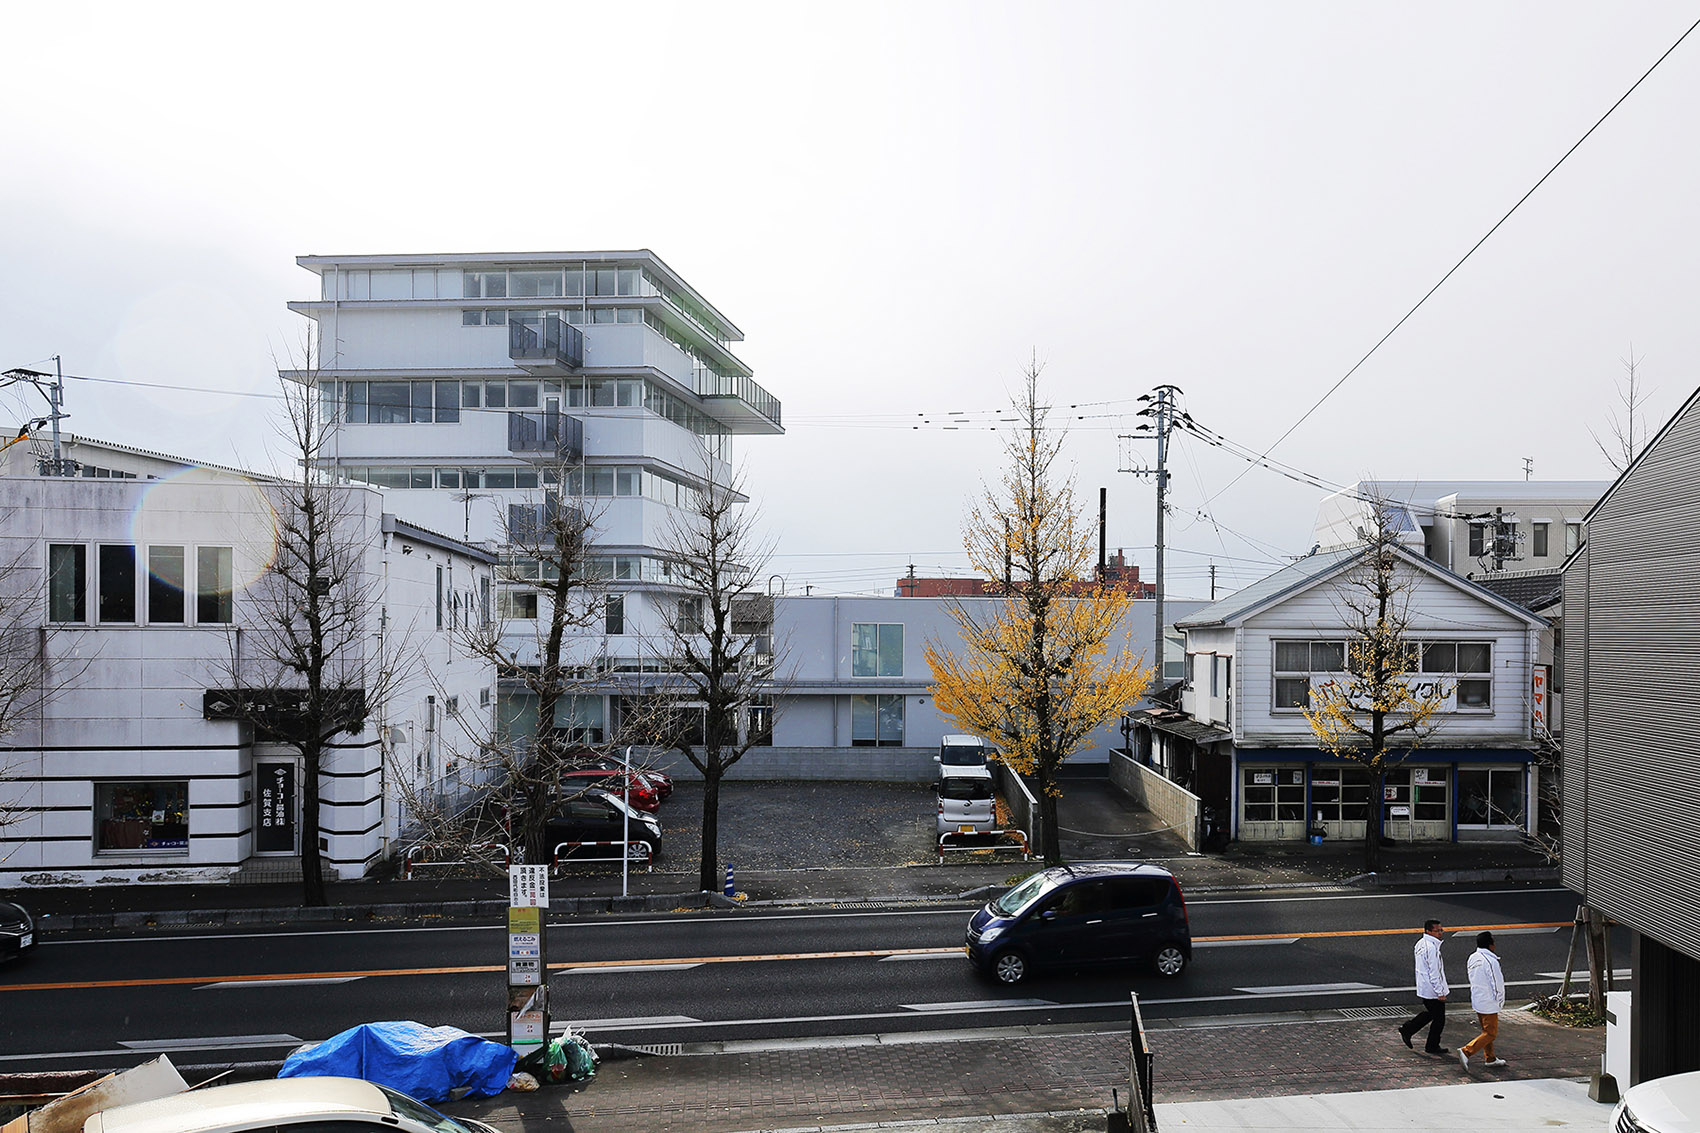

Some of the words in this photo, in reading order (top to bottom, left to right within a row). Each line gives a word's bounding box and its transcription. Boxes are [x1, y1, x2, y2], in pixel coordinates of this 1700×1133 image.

[1533, 675, 1544, 722] ヤマハ
[262, 788, 272, 827] 佐賀支店
